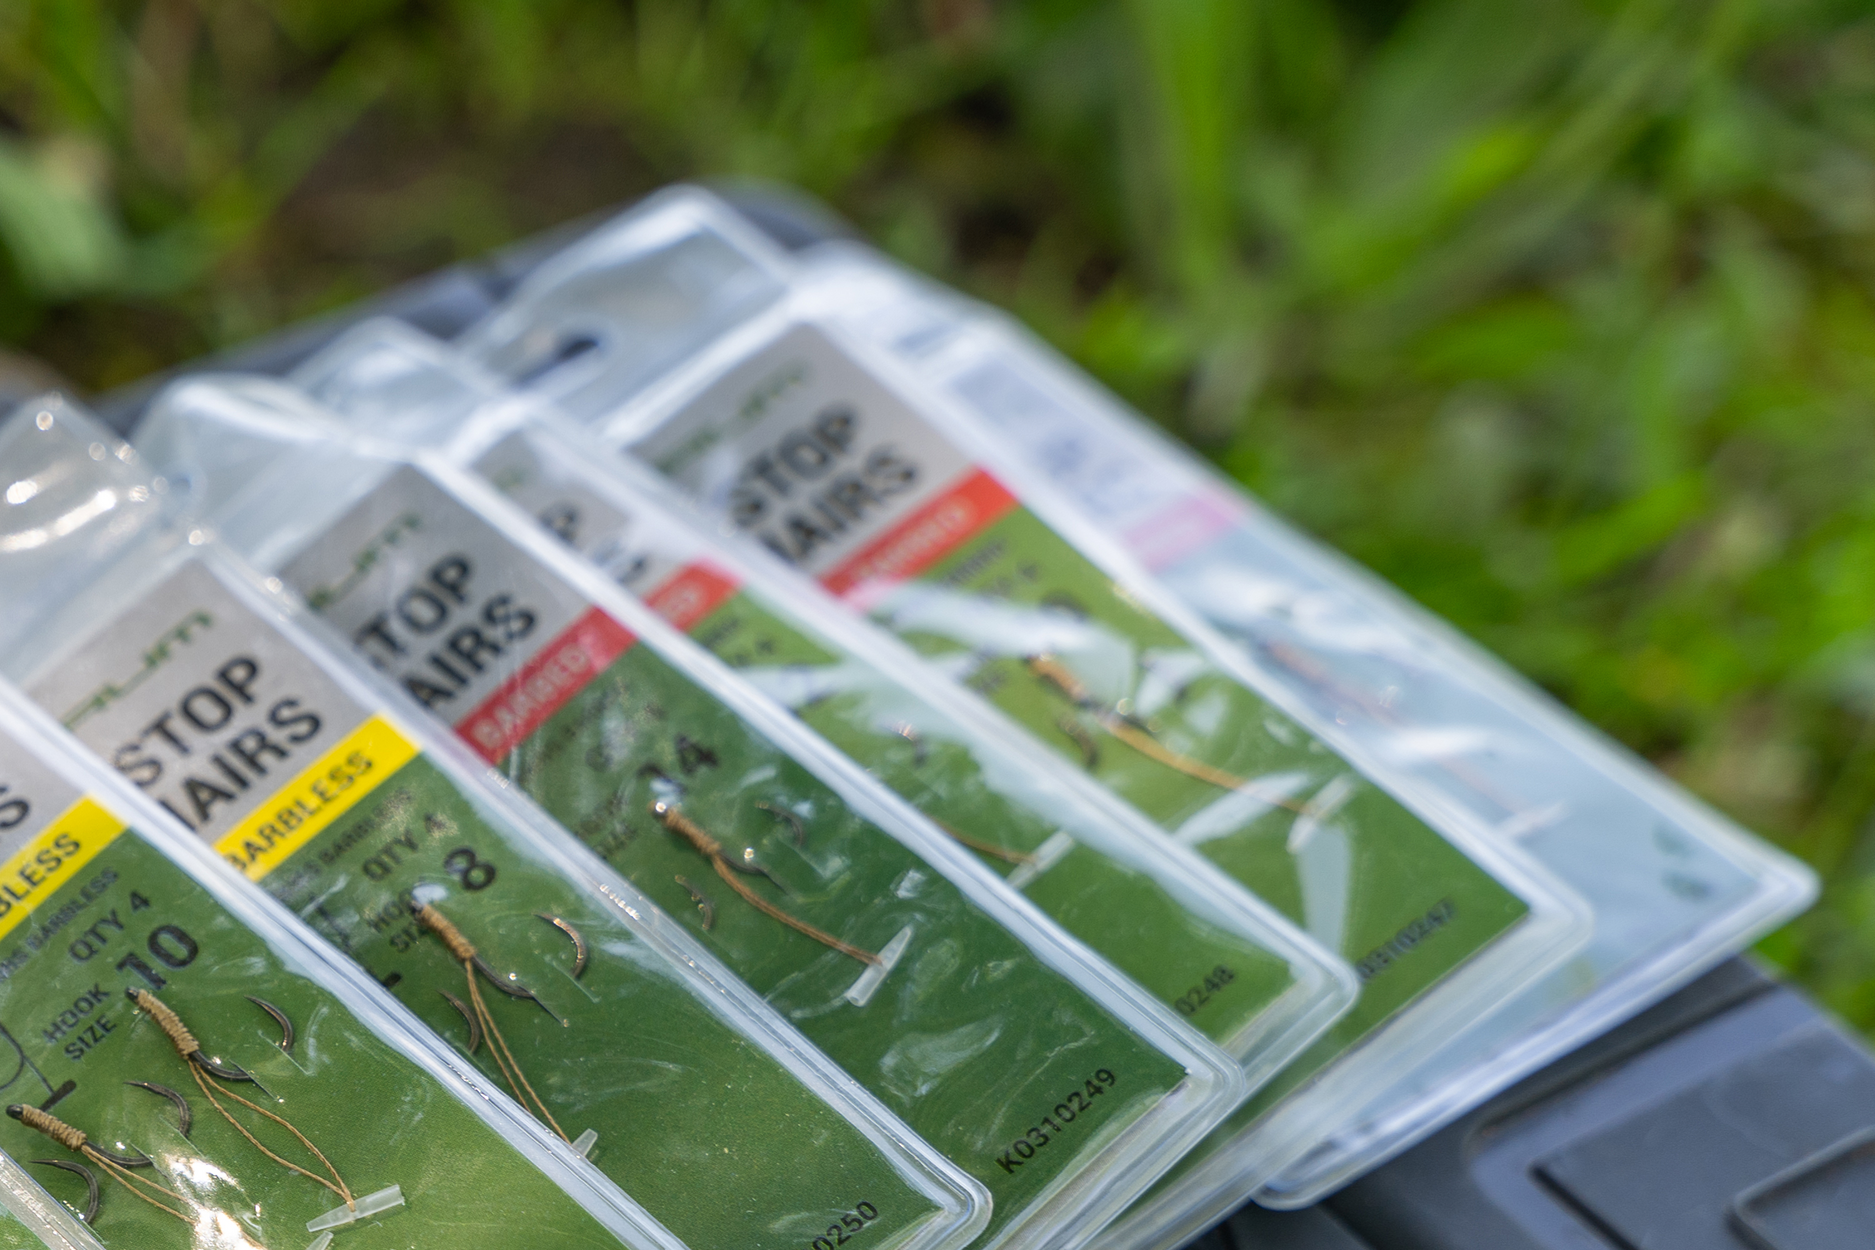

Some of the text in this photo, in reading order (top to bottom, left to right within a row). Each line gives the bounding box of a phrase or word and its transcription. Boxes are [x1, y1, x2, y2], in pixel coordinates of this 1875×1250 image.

[362, 827, 420, 883] QTY
[443, 846, 497, 891] 8
[68, 888, 151, 965] QTY 4
[115, 923, 199, 990] 10
[41, 983, 112, 1046] HOOK
[64, 1013, 118, 1062] SIZE
[995, 1067, 1116, 1175] K0310249
